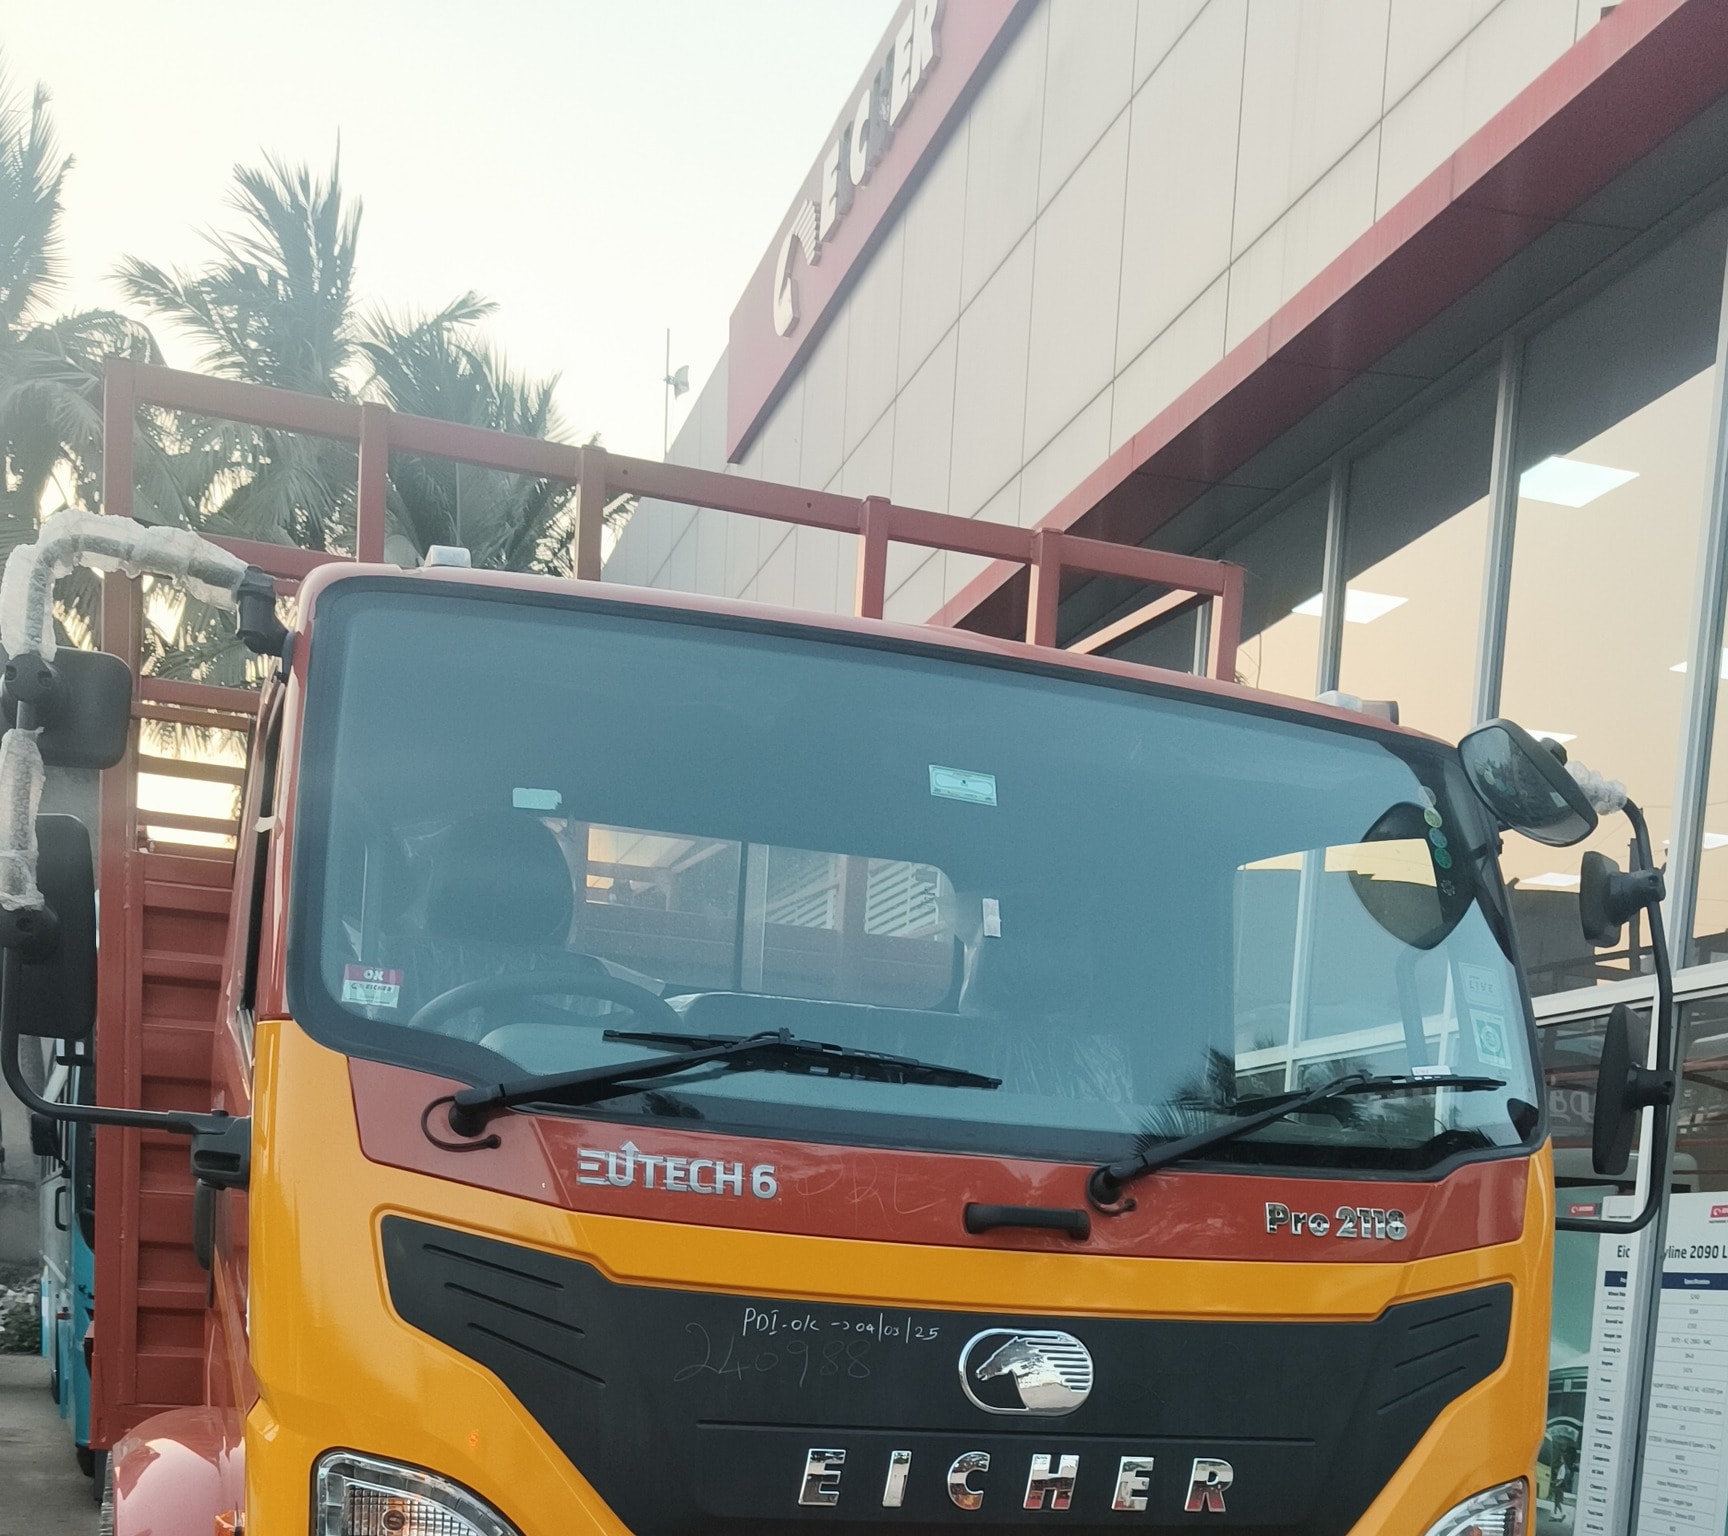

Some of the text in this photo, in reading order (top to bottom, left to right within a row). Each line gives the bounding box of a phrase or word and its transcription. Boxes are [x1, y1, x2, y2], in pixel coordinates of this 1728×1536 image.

[578, 1141, 778, 1200] EUTECH 6
[1265, 1202, 1408, 1241] Pro 2118
[1689, 1244, 1719, 1259] 2090
[798, 1448, 1235, 1513] EICHER
